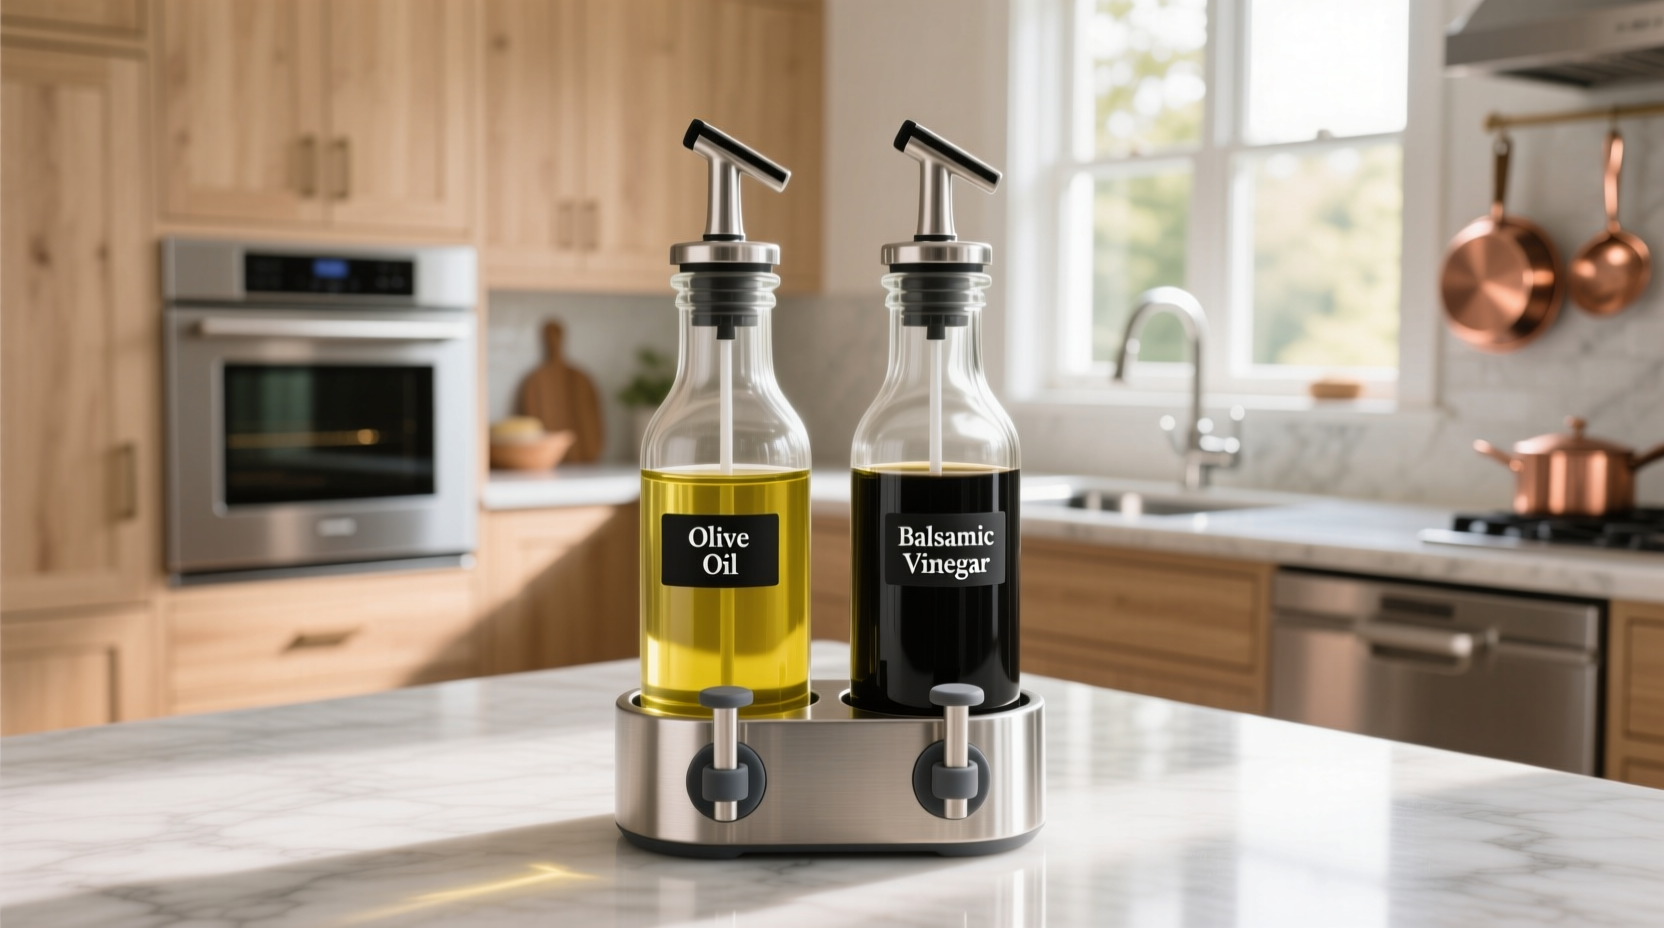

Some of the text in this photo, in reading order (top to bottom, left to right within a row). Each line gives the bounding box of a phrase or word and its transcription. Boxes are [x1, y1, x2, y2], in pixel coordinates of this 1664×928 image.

[688, 525, 750, 548] Olive
[898, 525, 995, 547] Balsamic
[702, 553, 739, 575] Oil
[902, 553, 991, 580] Vinegar
